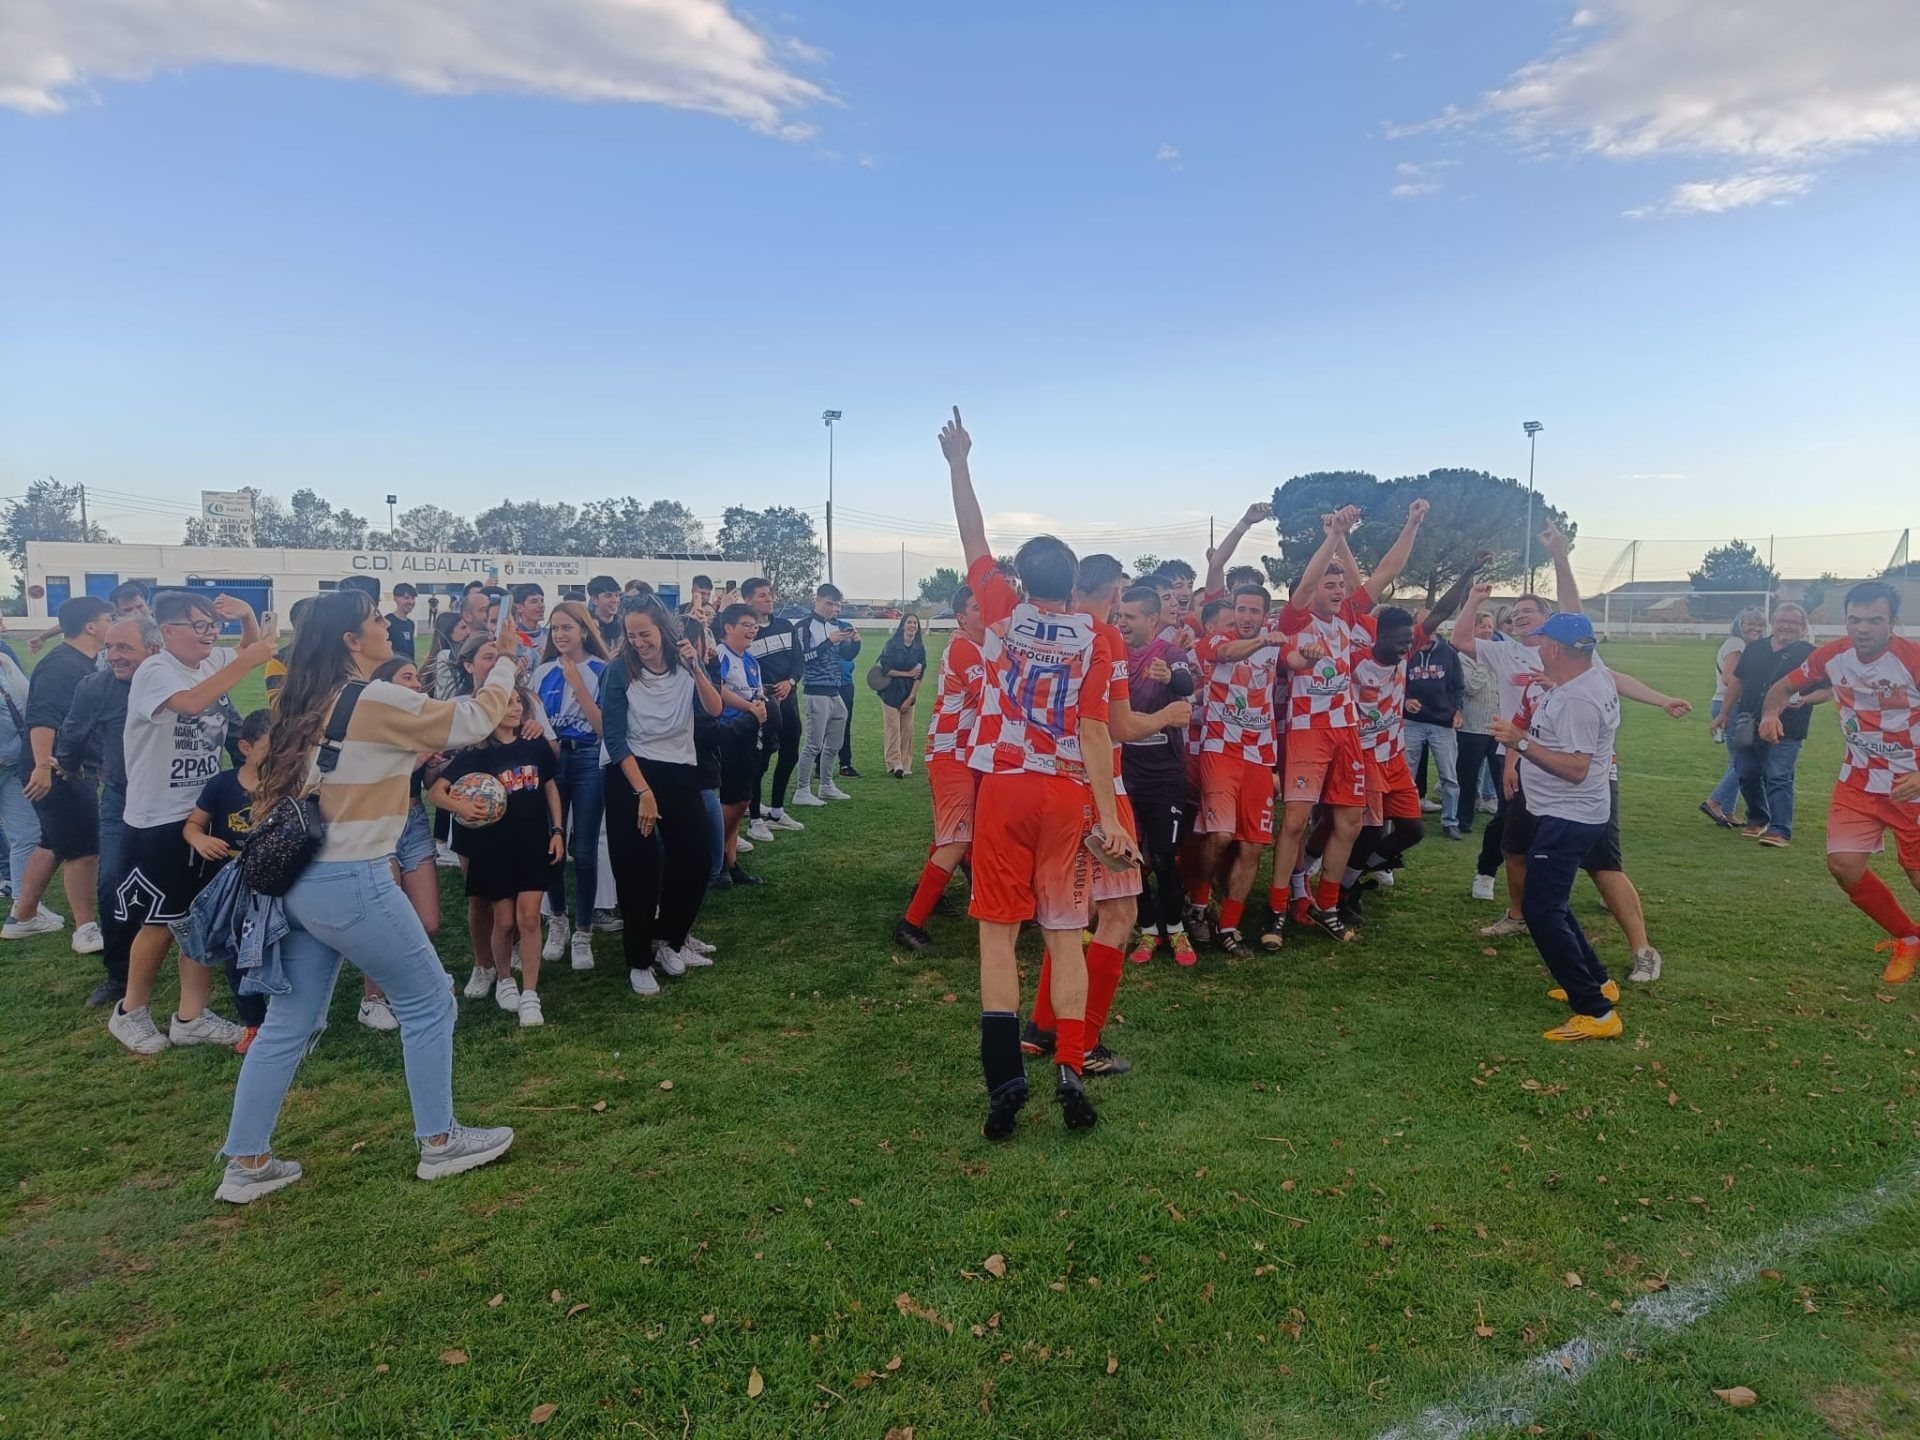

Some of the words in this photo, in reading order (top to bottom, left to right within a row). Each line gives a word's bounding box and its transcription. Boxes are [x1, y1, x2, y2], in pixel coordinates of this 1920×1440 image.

[352, 556, 393, 570] C.D.
[401, 557, 493, 572] ALBALATE
[175, 739, 199, 751] WORLD
[170, 755, 217, 780] 2PAC
